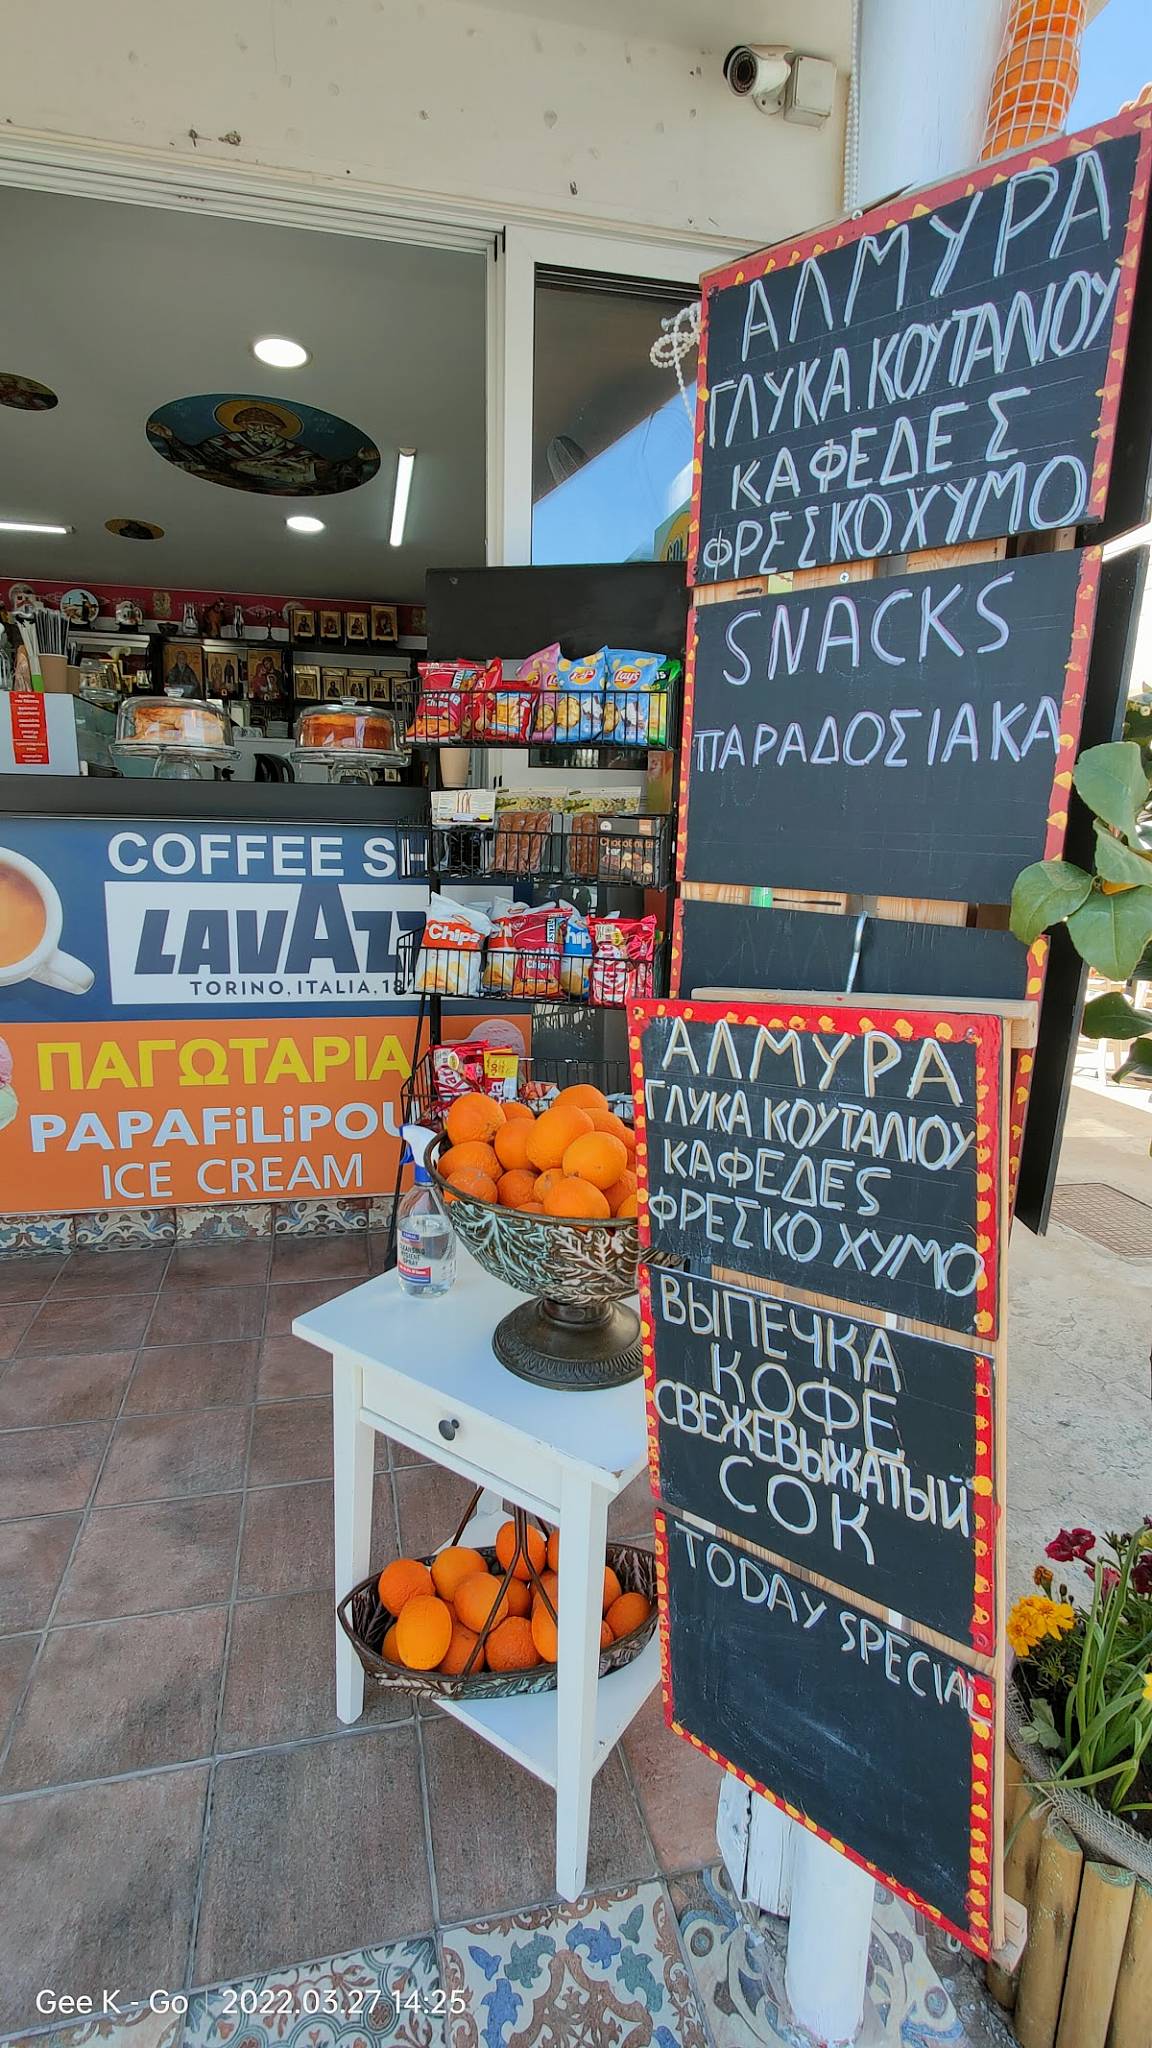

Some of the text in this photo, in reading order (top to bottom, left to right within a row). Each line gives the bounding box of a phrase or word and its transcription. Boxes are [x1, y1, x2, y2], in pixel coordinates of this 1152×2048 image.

[742, 150, 1112, 362] ΑΛΜΥΡΑ
[708, 346, 851, 448] ΓΛΥΚΑ
[732, 387, 1031, 511] ΚΑΦΕΔΕΣ
[899, 455, 1088, 552] ΧΥΜΟ
[723, 570, 1015, 686] SNACKS
[693, 695, 1062, 772] ΠΑΡΑΔΟΣΙΑΚΑ
[107, 831, 430, 879] COFFEE SH
[134, 884, 427, 975] LAVAZZ
[428, 922, 482, 948] Chips
[36, 1035, 412, 1091] ΠΑΓΩΤΑΡΙΑ
[661, 1016, 964, 1107] ΑΛΜΥΡΑ
[644, 1078, 975, 1171] ΓΛΥΚΑ ΚΟΥΤΑΛΙΟΥ
[102, 1152, 364, 1200] ICE CREAM
[648, 1186, 985, 1297] ΦΡΕΣΚΟ ΧΥΜΟ
[660, 1272, 901, 1393] ВЫПЕЧКА
[710, 1342, 905, 1462] КОФЕ
[653, 1380, 970, 1538] СВЕЖЕВЫЖАТЫЙ
[719, 1454, 875, 1566] СОК
[674, 1521, 828, 1629] TODAY
